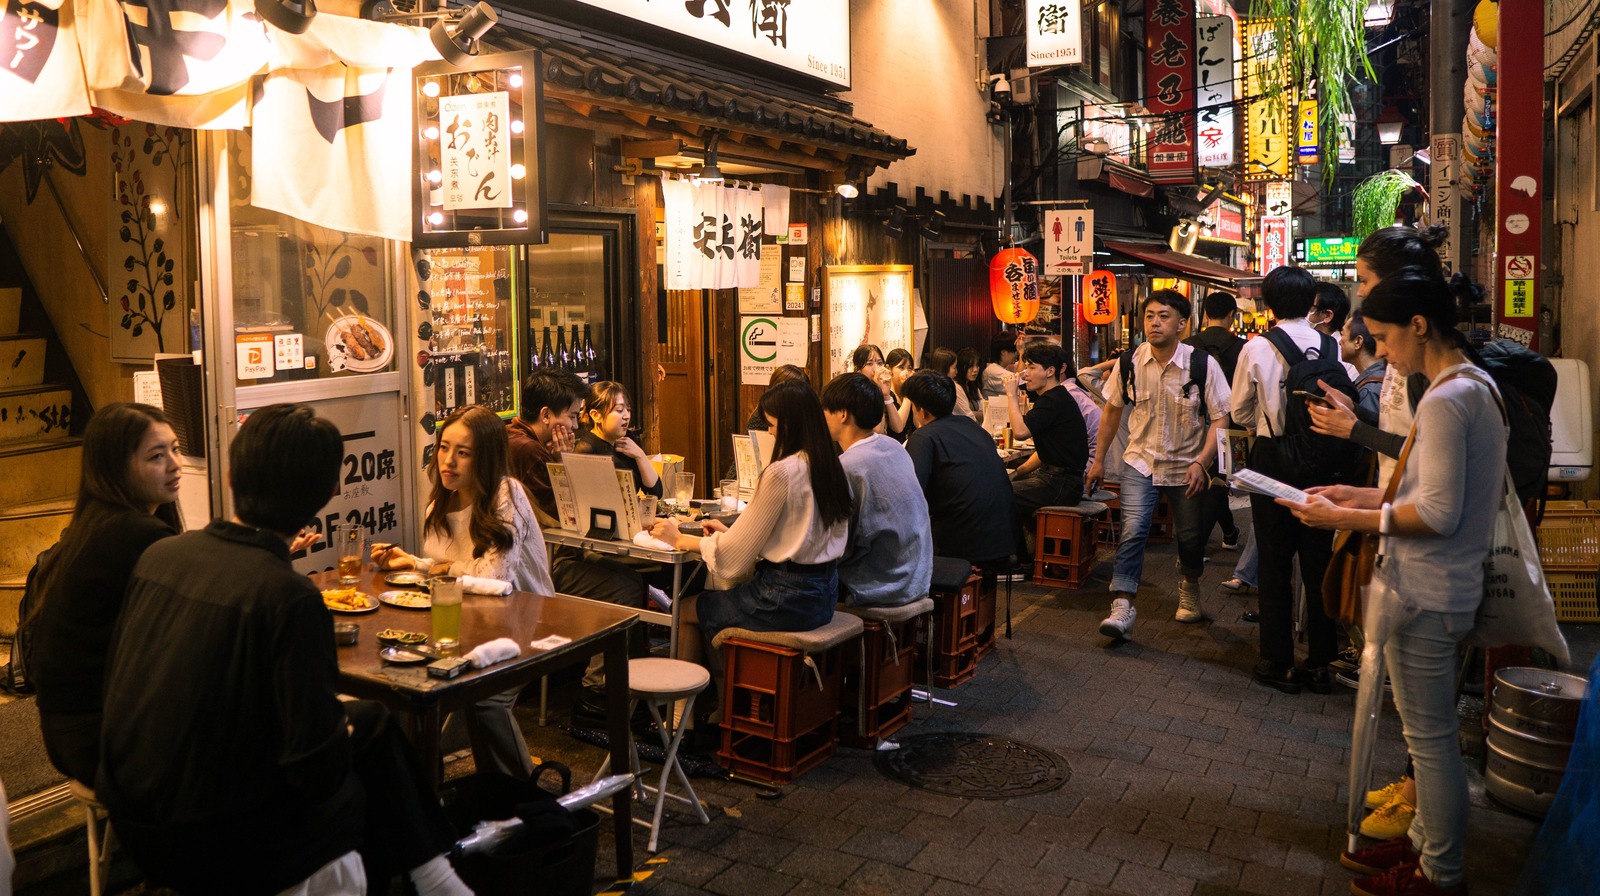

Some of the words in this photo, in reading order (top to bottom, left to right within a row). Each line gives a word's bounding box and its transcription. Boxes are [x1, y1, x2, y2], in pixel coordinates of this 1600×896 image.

[1037, 3, 1068, 36] 衛
[807, 53, 828, 74] Since
[830, 62, 846, 80] 1951
[1030, 47, 1077, 61] Since1951
[1302, 120, 1314, 141] 松屋
[446, 114, 502, 201] おでん
[1155, 153, 1187, 163] 加盟店
[693, 211, 762, 261] 安兵衛
[1056, 246, 1081, 254] トイレ
[1021, 256, 1038, 301] 旨い酒
[1512, 280, 1526, 314] 路上喫煙禁止
[244, 365, 267, 374] PayPay
[343, 449, 396, 486] 20席
[344, 484, 374, 500] お座敷
